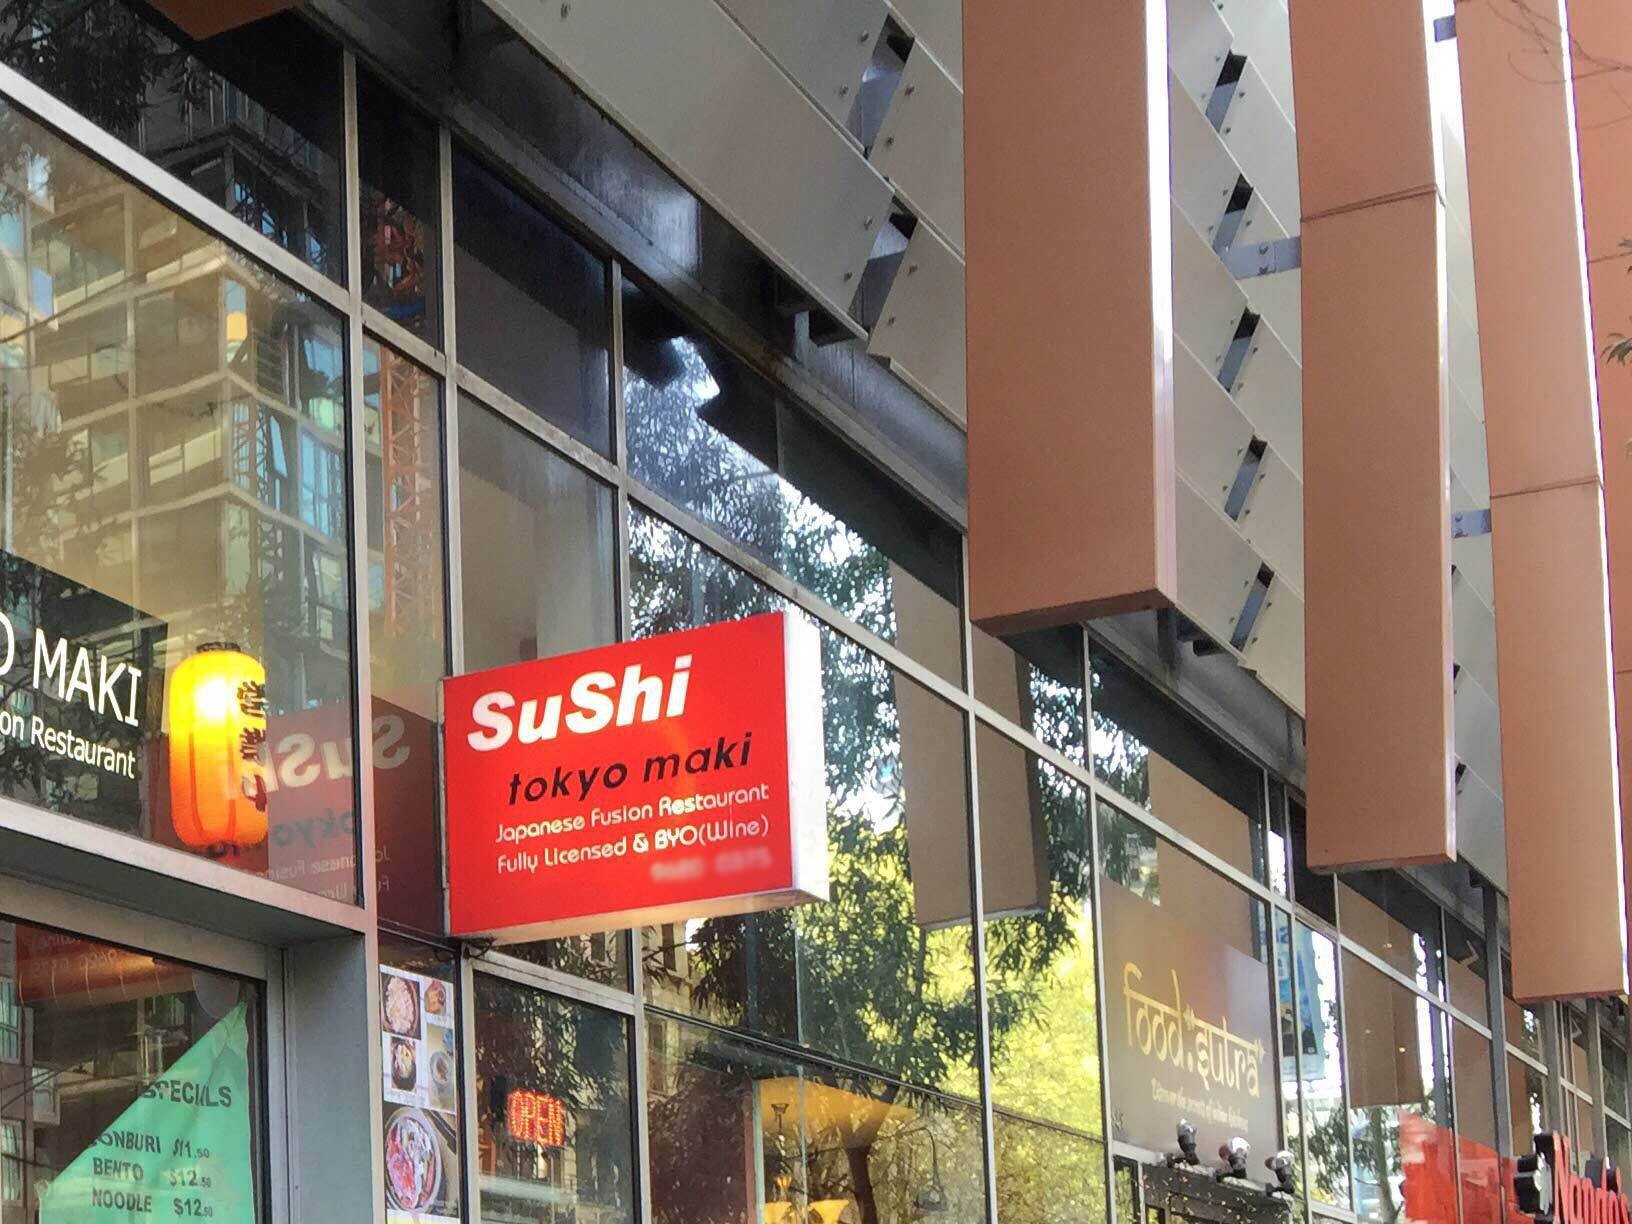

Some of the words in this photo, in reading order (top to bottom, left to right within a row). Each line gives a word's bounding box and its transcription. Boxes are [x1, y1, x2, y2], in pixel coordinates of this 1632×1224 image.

[33, 628, 142, 727] MAKI
[467, 654, 693, 752] SuShi
[30, 715, 136, 780] Restaurant
[508, 761, 628, 805] tokyo
[643, 732, 752, 782] maki
[495, 814, 585, 844] Japanese
[590, 804, 653, 828] Fusion
[659, 784, 769, 818] Restaurant
[497, 850, 539, 875] Fully
[544, 838, 628, 867] Licensed
[633, 833, 648, 854] &
[509, 1089, 565, 1146] OPEN
[93, 1157, 144, 1181] BENTO
[92, 1188, 153, 1213] NOODLE
